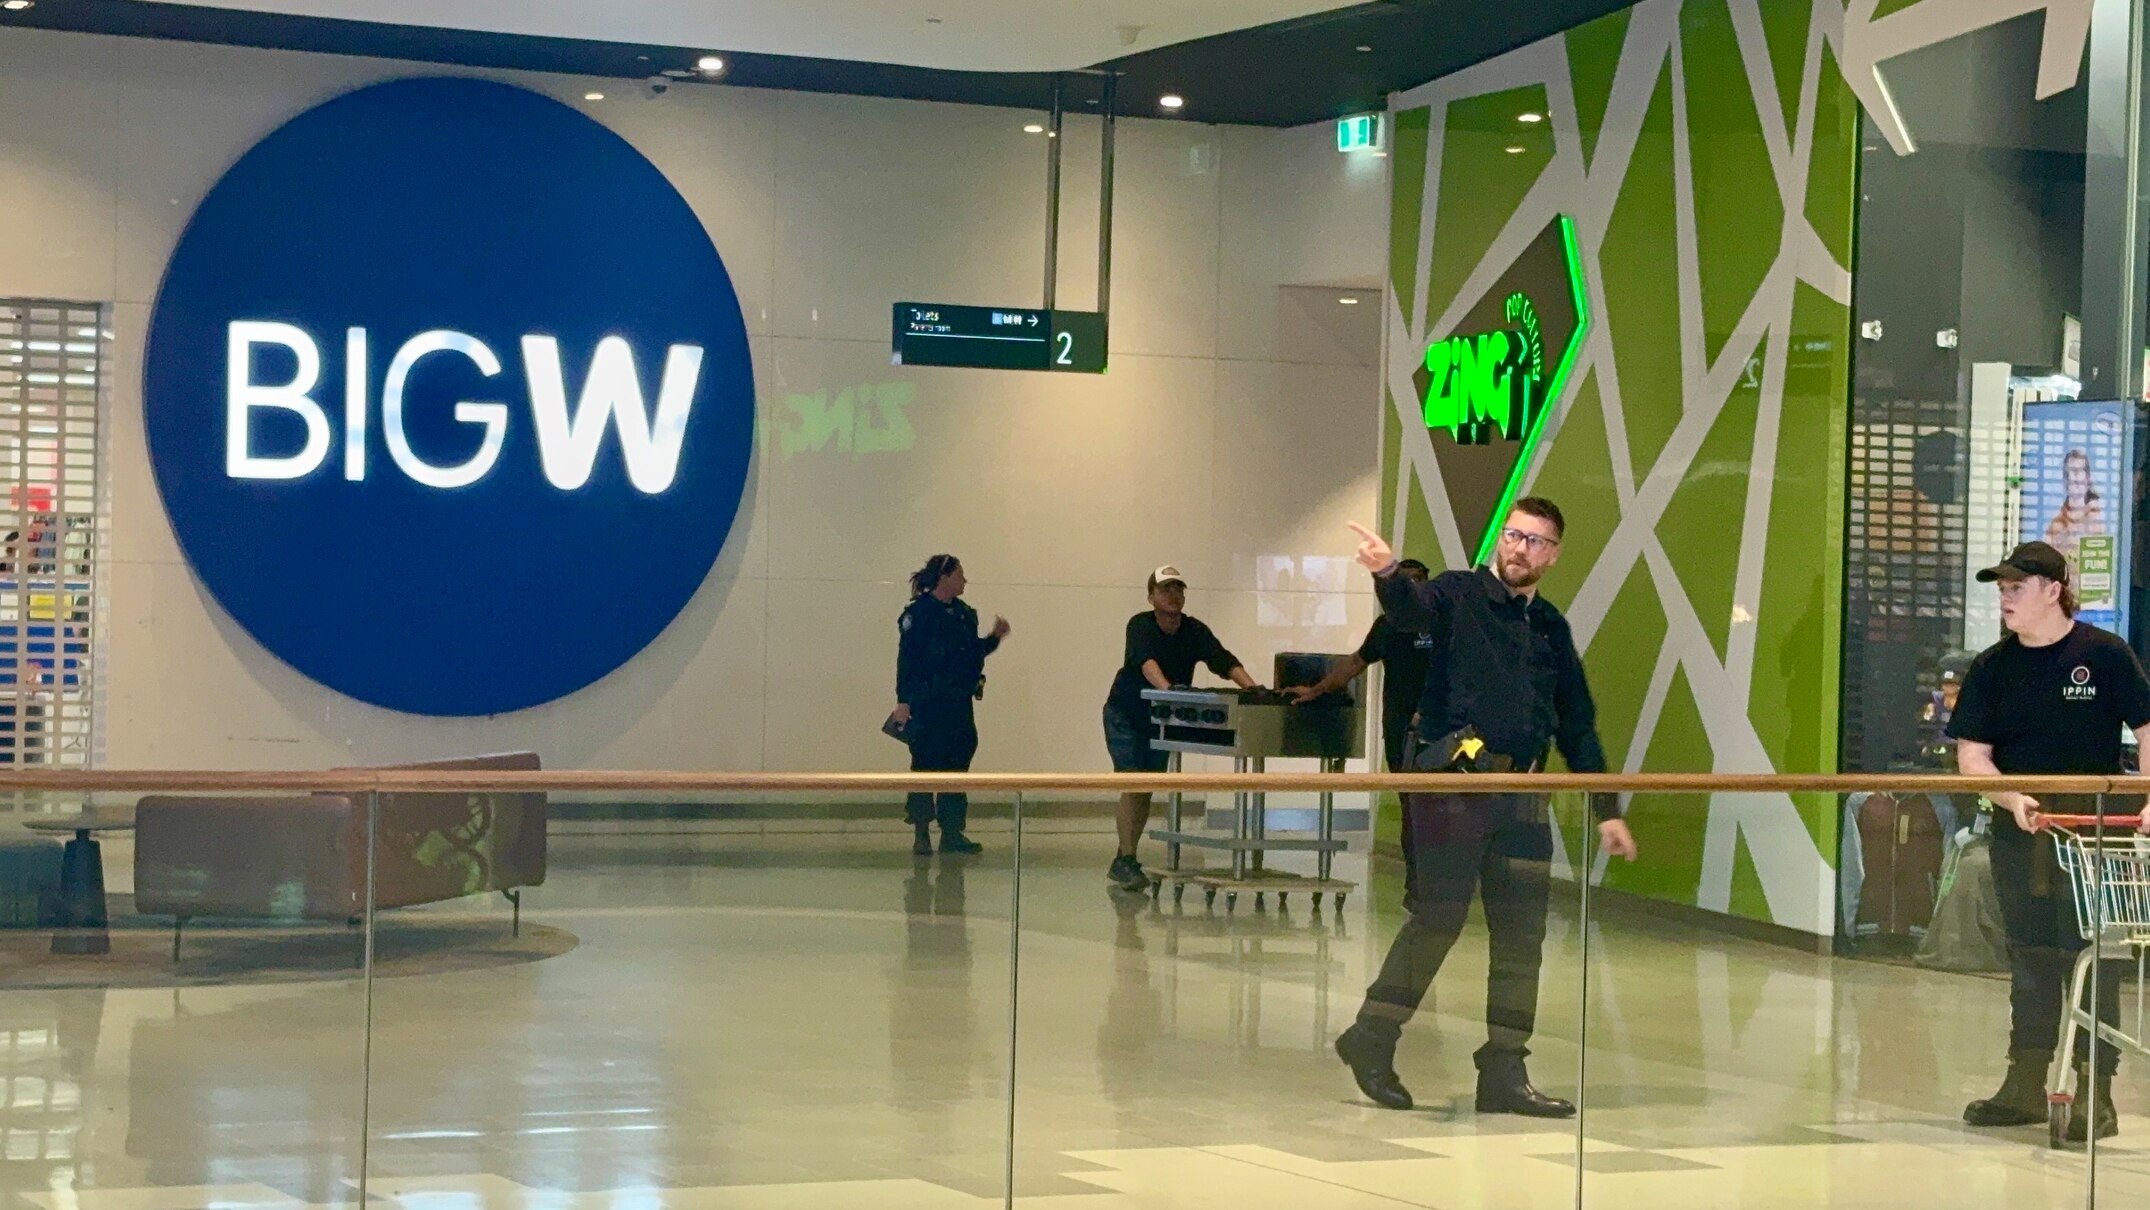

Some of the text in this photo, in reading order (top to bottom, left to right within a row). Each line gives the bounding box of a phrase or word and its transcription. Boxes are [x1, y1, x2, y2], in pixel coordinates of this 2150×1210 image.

[1506, 292, 1523, 323] POP
[1056, 331, 1072, 364] 2
[2063, 686, 2096, 696] IPPIN
